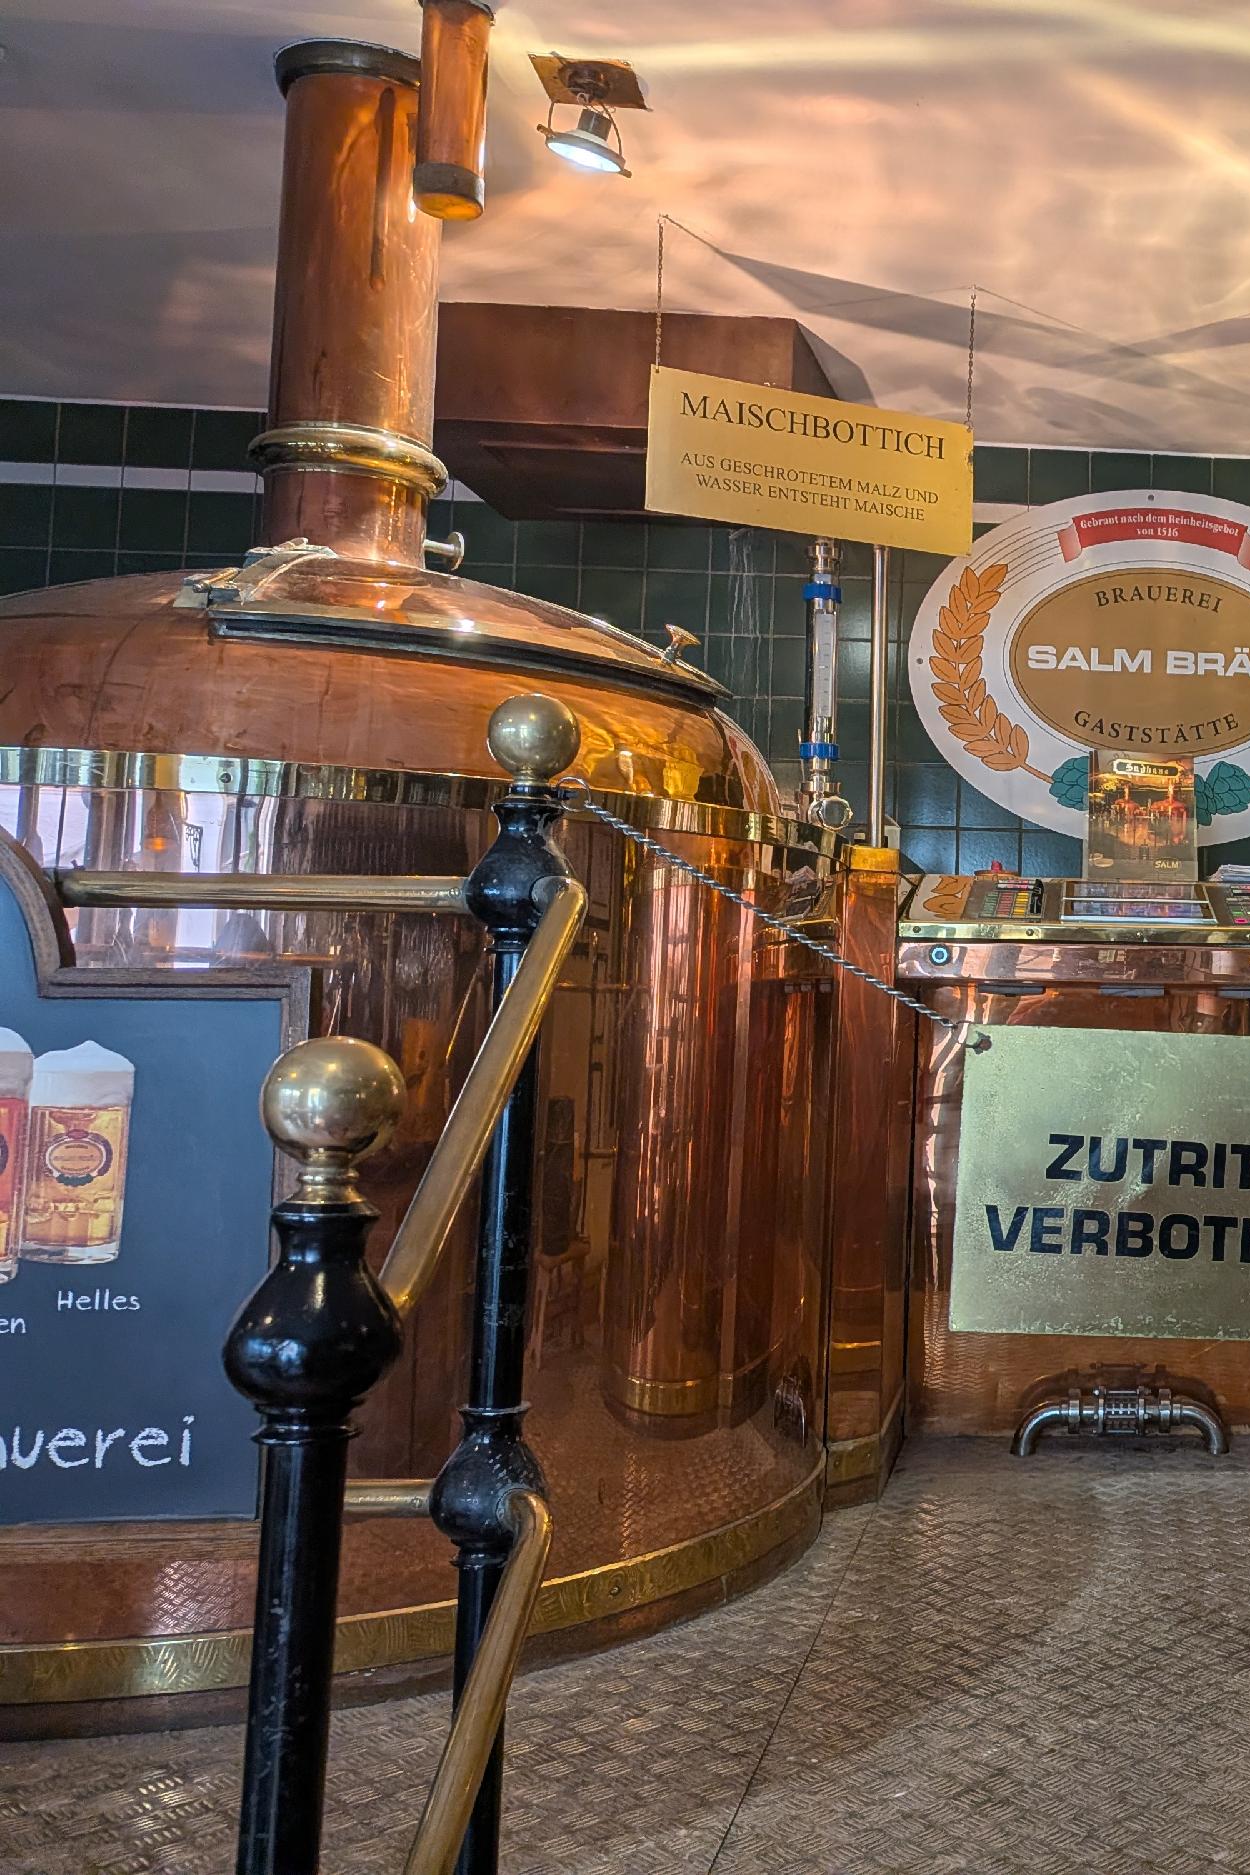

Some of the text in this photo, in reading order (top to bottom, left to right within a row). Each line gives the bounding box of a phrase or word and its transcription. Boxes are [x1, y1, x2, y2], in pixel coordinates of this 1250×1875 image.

[680, 391, 945, 460] MAISCHBOTTICH
[681, 452, 939, 505] AUS GESCHROTETEM MALZ UND
[696, 473, 925, 522] WASSER ENTSTEHT MAISCHE
[1121, 513, 1144, 525] nach
[1145, 513, 1167, 524] dem
[1168, 514, 1240, 537] Reinheitsgebot
[1136, 527, 1179, 537] von 1516
[1095, 584, 1223, 614] BRAUEREI
[1027, 645, 1152, 674] SALM
[1074, 709, 1239, 744] GASTSTÄTTE
[1154, 860, 1179, 869] SALM
[57, 1288, 142, 1312] Helles
[0, 1317, 27, 1334] en
